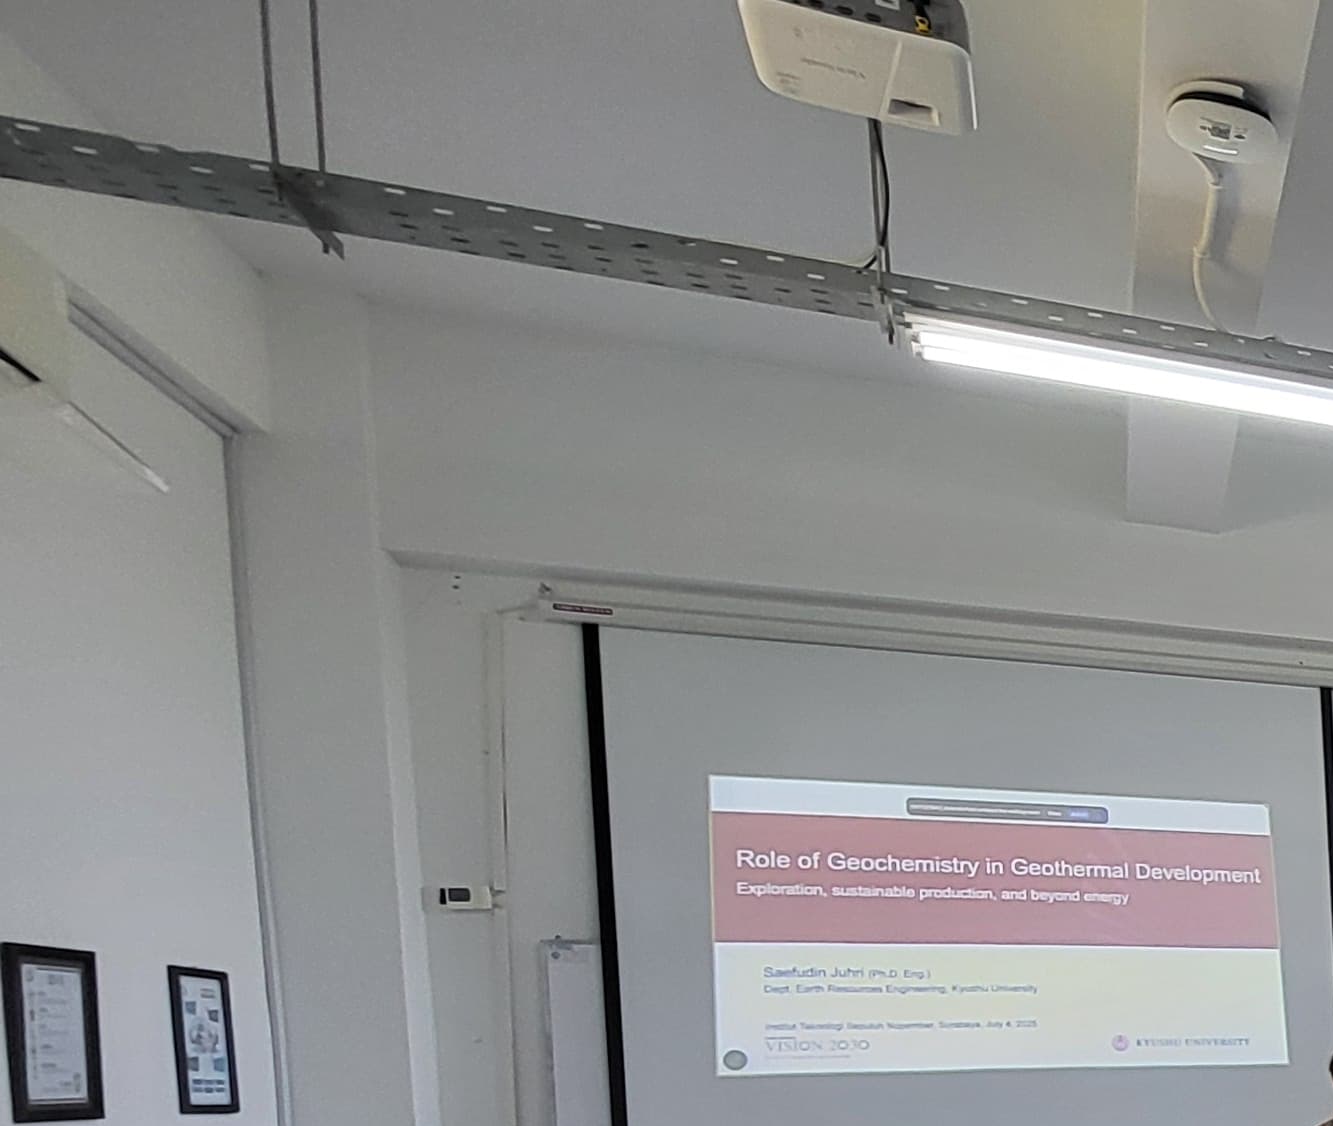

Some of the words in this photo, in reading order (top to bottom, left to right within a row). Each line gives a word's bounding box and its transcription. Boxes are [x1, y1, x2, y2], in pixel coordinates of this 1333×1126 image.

[735, 849, 791, 869] Role
[797, 851, 821, 870] of
[827, 852, 980, 878] Geochemistry
[985, 857, 1004, 875] in
[1010, 858, 1129, 879] Geothermal
[1135, 862, 1262, 885] Development
[736, 881, 828, 898] Exploration,
[831, 884, 916, 899] sustainable
[919, 886, 998, 901] production,
[1001, 889, 1027, 901] and
[1030, 889, 1081, 904] beyond
[1083, 892, 1130, 905] energy
[763, 966, 826, 979] Saefudin
[830, 967, 865, 979] Juhri
